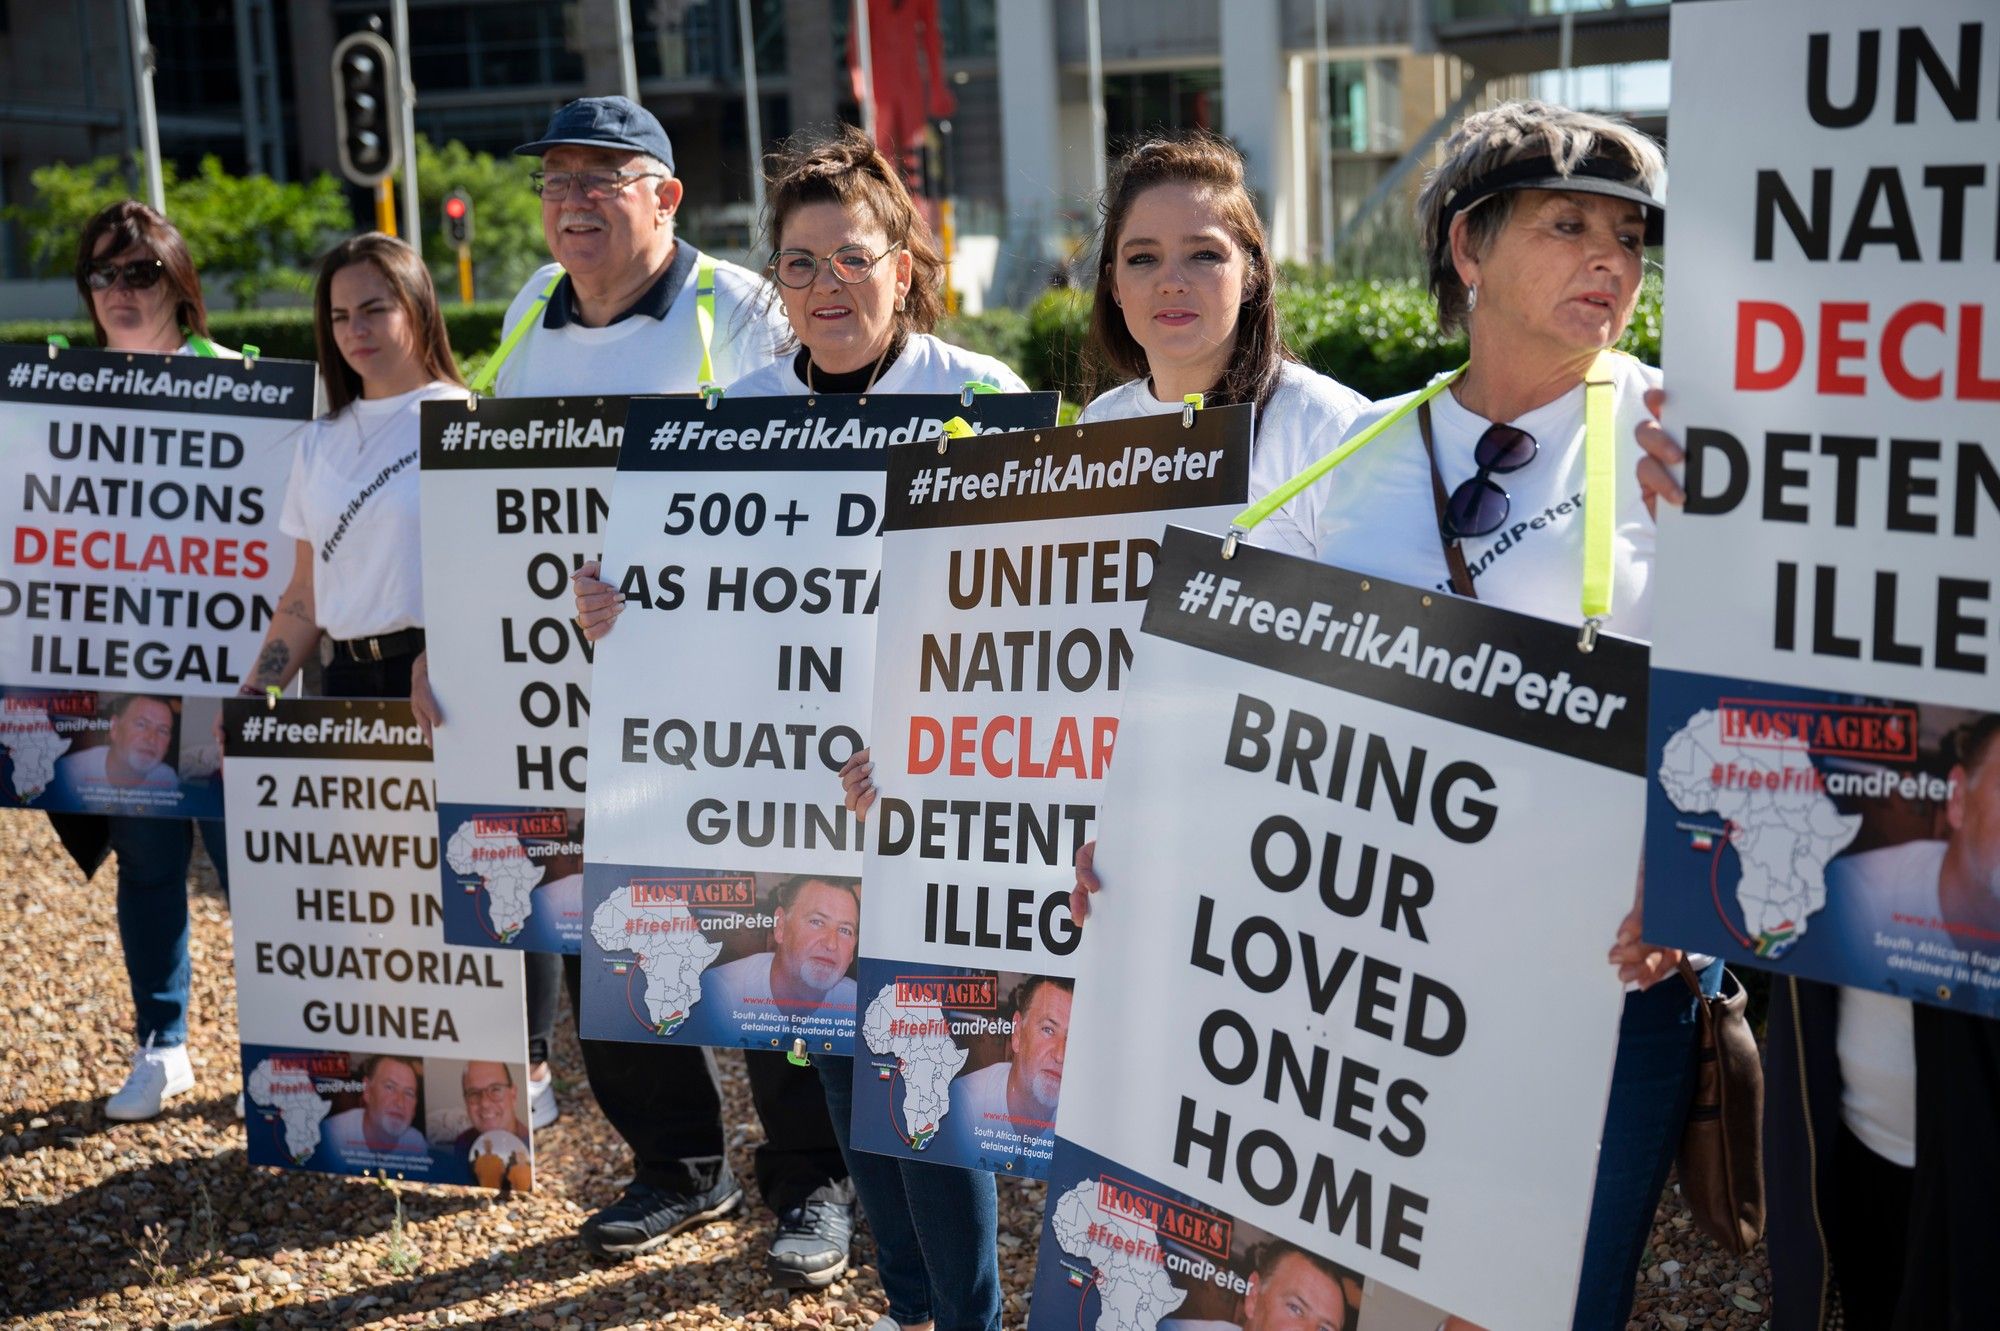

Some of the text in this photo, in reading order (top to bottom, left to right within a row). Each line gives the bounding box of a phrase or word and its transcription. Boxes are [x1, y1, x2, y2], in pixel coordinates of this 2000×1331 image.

[1806, 22, 2000, 130] UN
[1753, 163, 2000, 263] NAT
[1734, 300, 2000, 402] DECL
[8, 362, 293, 405] #FreeFrikAndPeter
[48, 421, 244, 469] UNITED
[441, 417, 625, 451] #FreeFrikAn
[23, 474, 265, 526] NATIONS
[908, 447, 1224, 505] #FreeFrikAndPeter
[321, 449, 418, 562] #FreeFrikAndPeter
[663, 492, 884, 537] 500+ D
[13, 527, 269, 580] DECLARES
[1436, 493, 1584, 595] AndPeter
[618, 565, 685, 610] AS
[948, 537, 1163, 611] UNITED
[1774, 561, 1990, 675] ILLE
[31, 635, 240, 685] ILLEGAL
[778, 645, 842, 693] IN
[1178, 570, 1627, 731] #FreeFrikAndPeter
[621, 718, 865, 773] EQUATO
[1722, 707, 1906, 752] HOSTAGES
[1224, 693, 1499, 845] BRING
[1711, 763, 1957, 802] #FreeFrikandPeter
[256, 776, 437, 812] 2 AFRICA
[475, 816, 563, 834] HOSTAGES
[246, 831, 439, 870] UNLAWFU
[633, 881, 748, 903] HOSTAGES
[1250, 814, 1435, 945] OUR
[297, 889, 394, 925] HELD
[625, 914, 780, 935] #FreeFrikandPeter
[924, 882, 1083, 957] ILLEG
[255, 942, 504, 988] EQUATORIAL
[1189, 894, 1467, 1058] LOVED
[897, 982, 992, 1004] HOSTAGES
[303, 1001, 459, 1042] GUINEA
[732, 1010, 756, 1020] South
[758, 1012, 789, 1023] African
[791, 1014, 832, 1026] Engineers
[741, 1022, 780, 1033] detained
[782, 1024, 790, 1033] in
[791, 1025, 835, 1037] Equatorial
[889, 1016, 1017, 1037] #FreeFrikandPeter
[1198, 1008, 1429, 1159] ONES
[974, 1126, 994, 1138] South
[995, 1130, 1022, 1142] African
[981, 1140, 1014, 1154] detained
[1015, 1145, 1022, 1156] in
[1172, 1095, 1430, 1271] HOME
[1100, 1181, 1225, 1250] HOSTAGES
[1087, 1222, 1255, 1296] #FreeFrikandPeter
